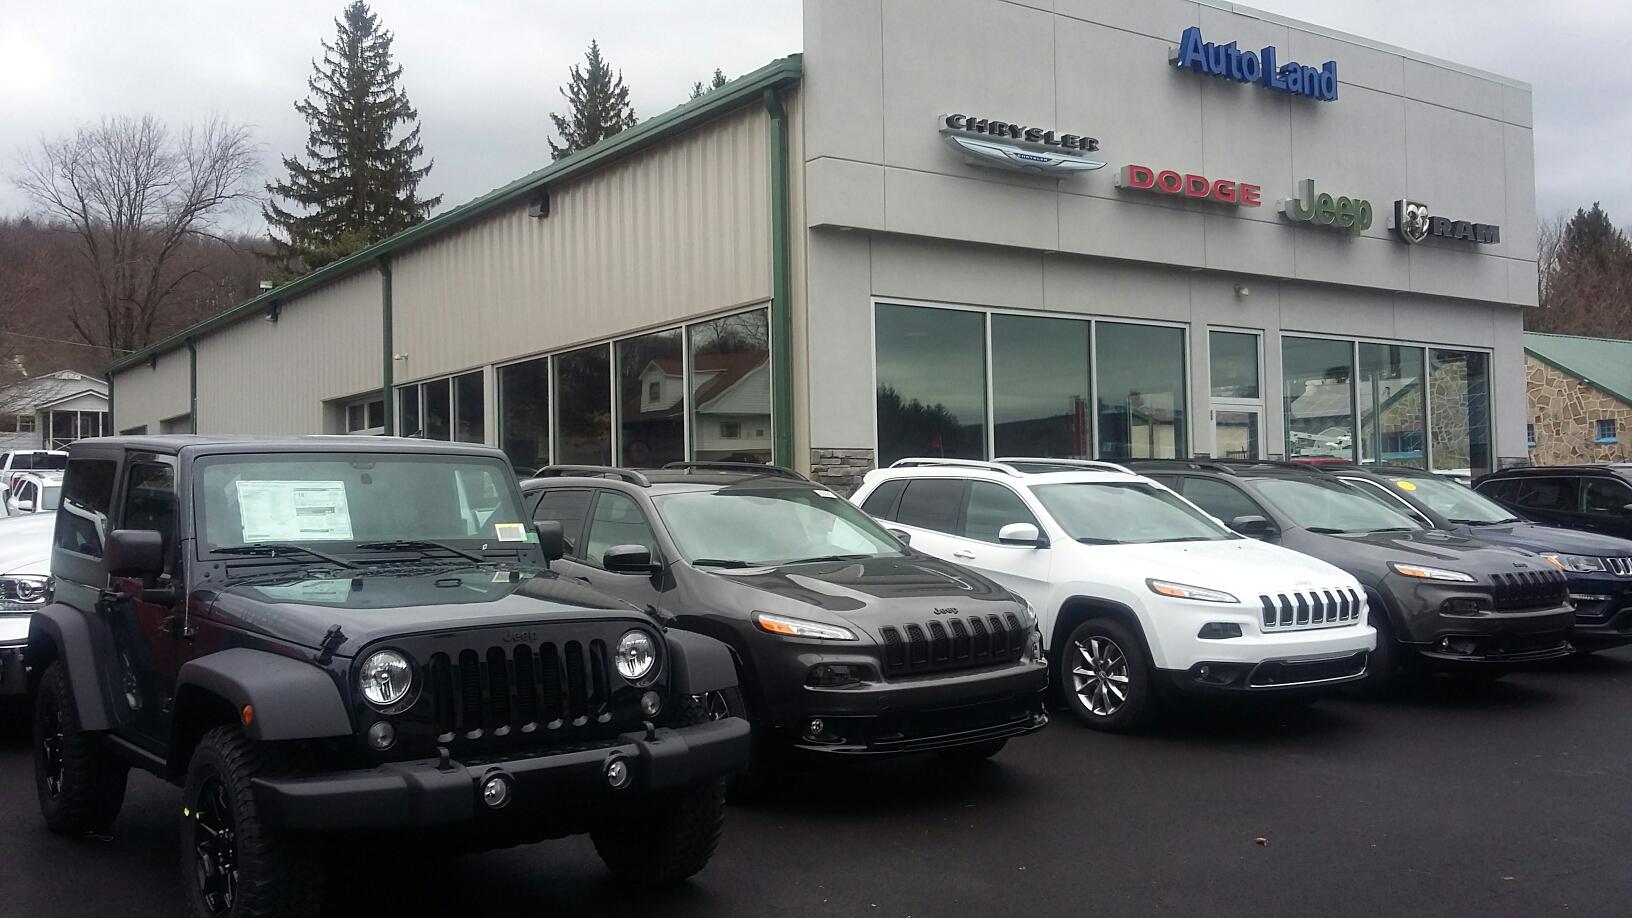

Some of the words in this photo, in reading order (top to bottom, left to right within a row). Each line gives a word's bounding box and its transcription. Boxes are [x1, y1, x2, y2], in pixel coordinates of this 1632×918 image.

[1179, 26, 1261, 83] Auto
[1261, 46, 1338, 101] Land
[946, 113, 1100, 152] CHRYSLER
[1128, 164, 1261, 207] DODGE
[1286, 179, 1373, 236] Jeep
[1429, 216, 1501, 244] RAM
[933, 607, 959, 615] Jeep
[502, 627, 537, 643] Jeep
